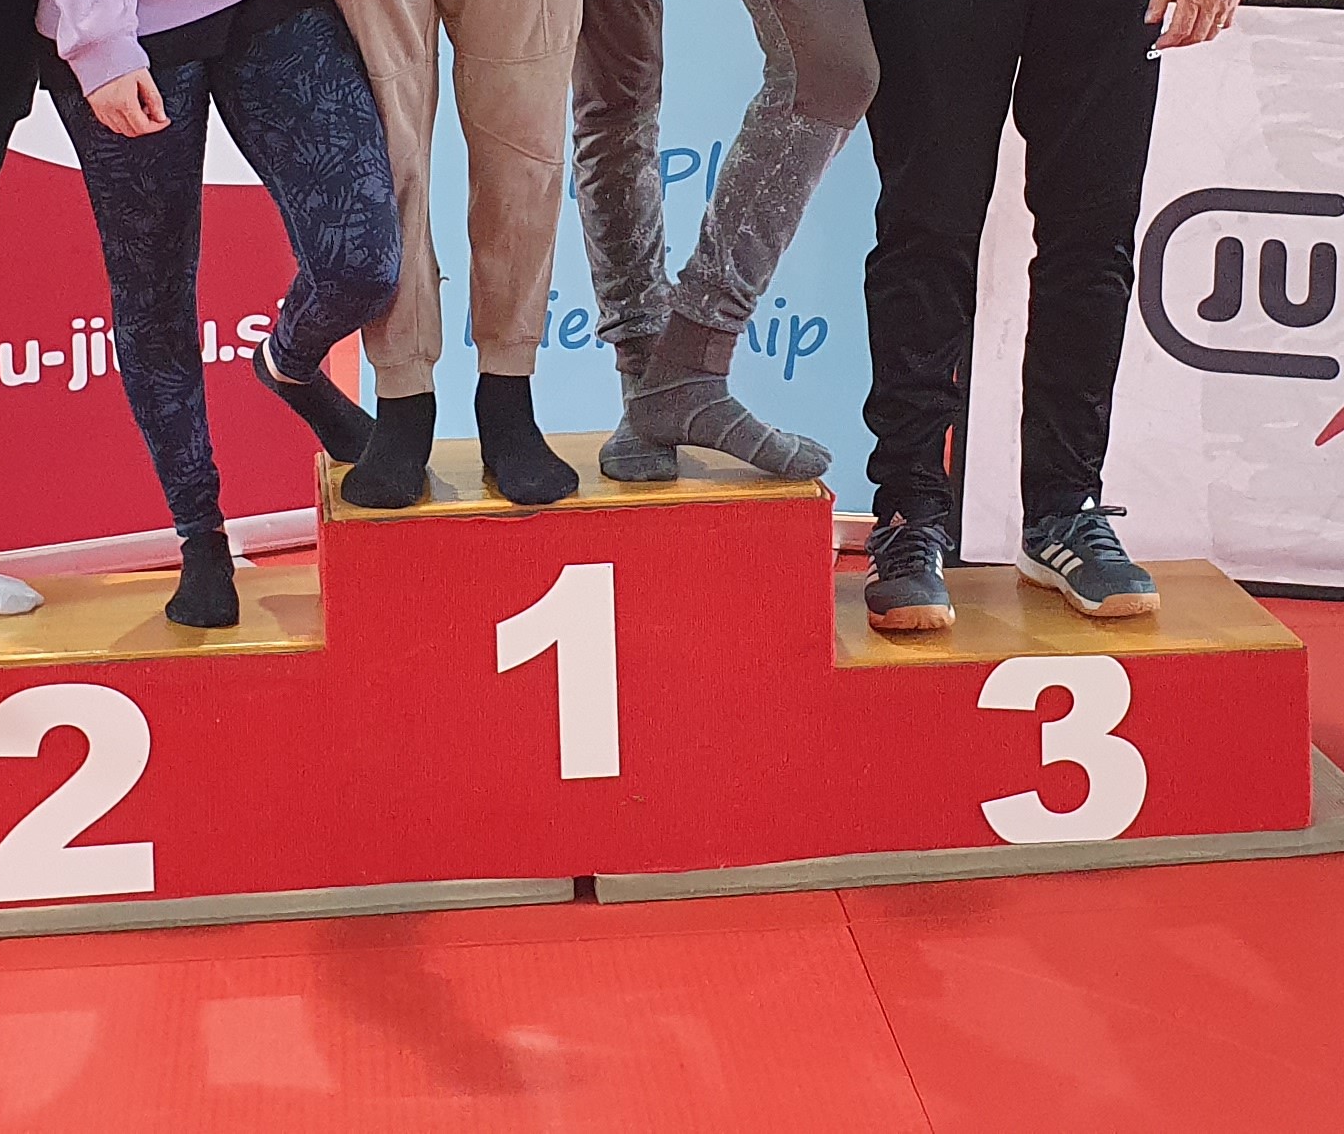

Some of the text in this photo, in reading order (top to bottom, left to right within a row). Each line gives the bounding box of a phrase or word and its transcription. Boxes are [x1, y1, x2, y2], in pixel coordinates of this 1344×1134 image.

[1195, 237, 1337, 327] JU
[495, 561, 620, 780] 1
[979, 654, 1148, 844] 3
